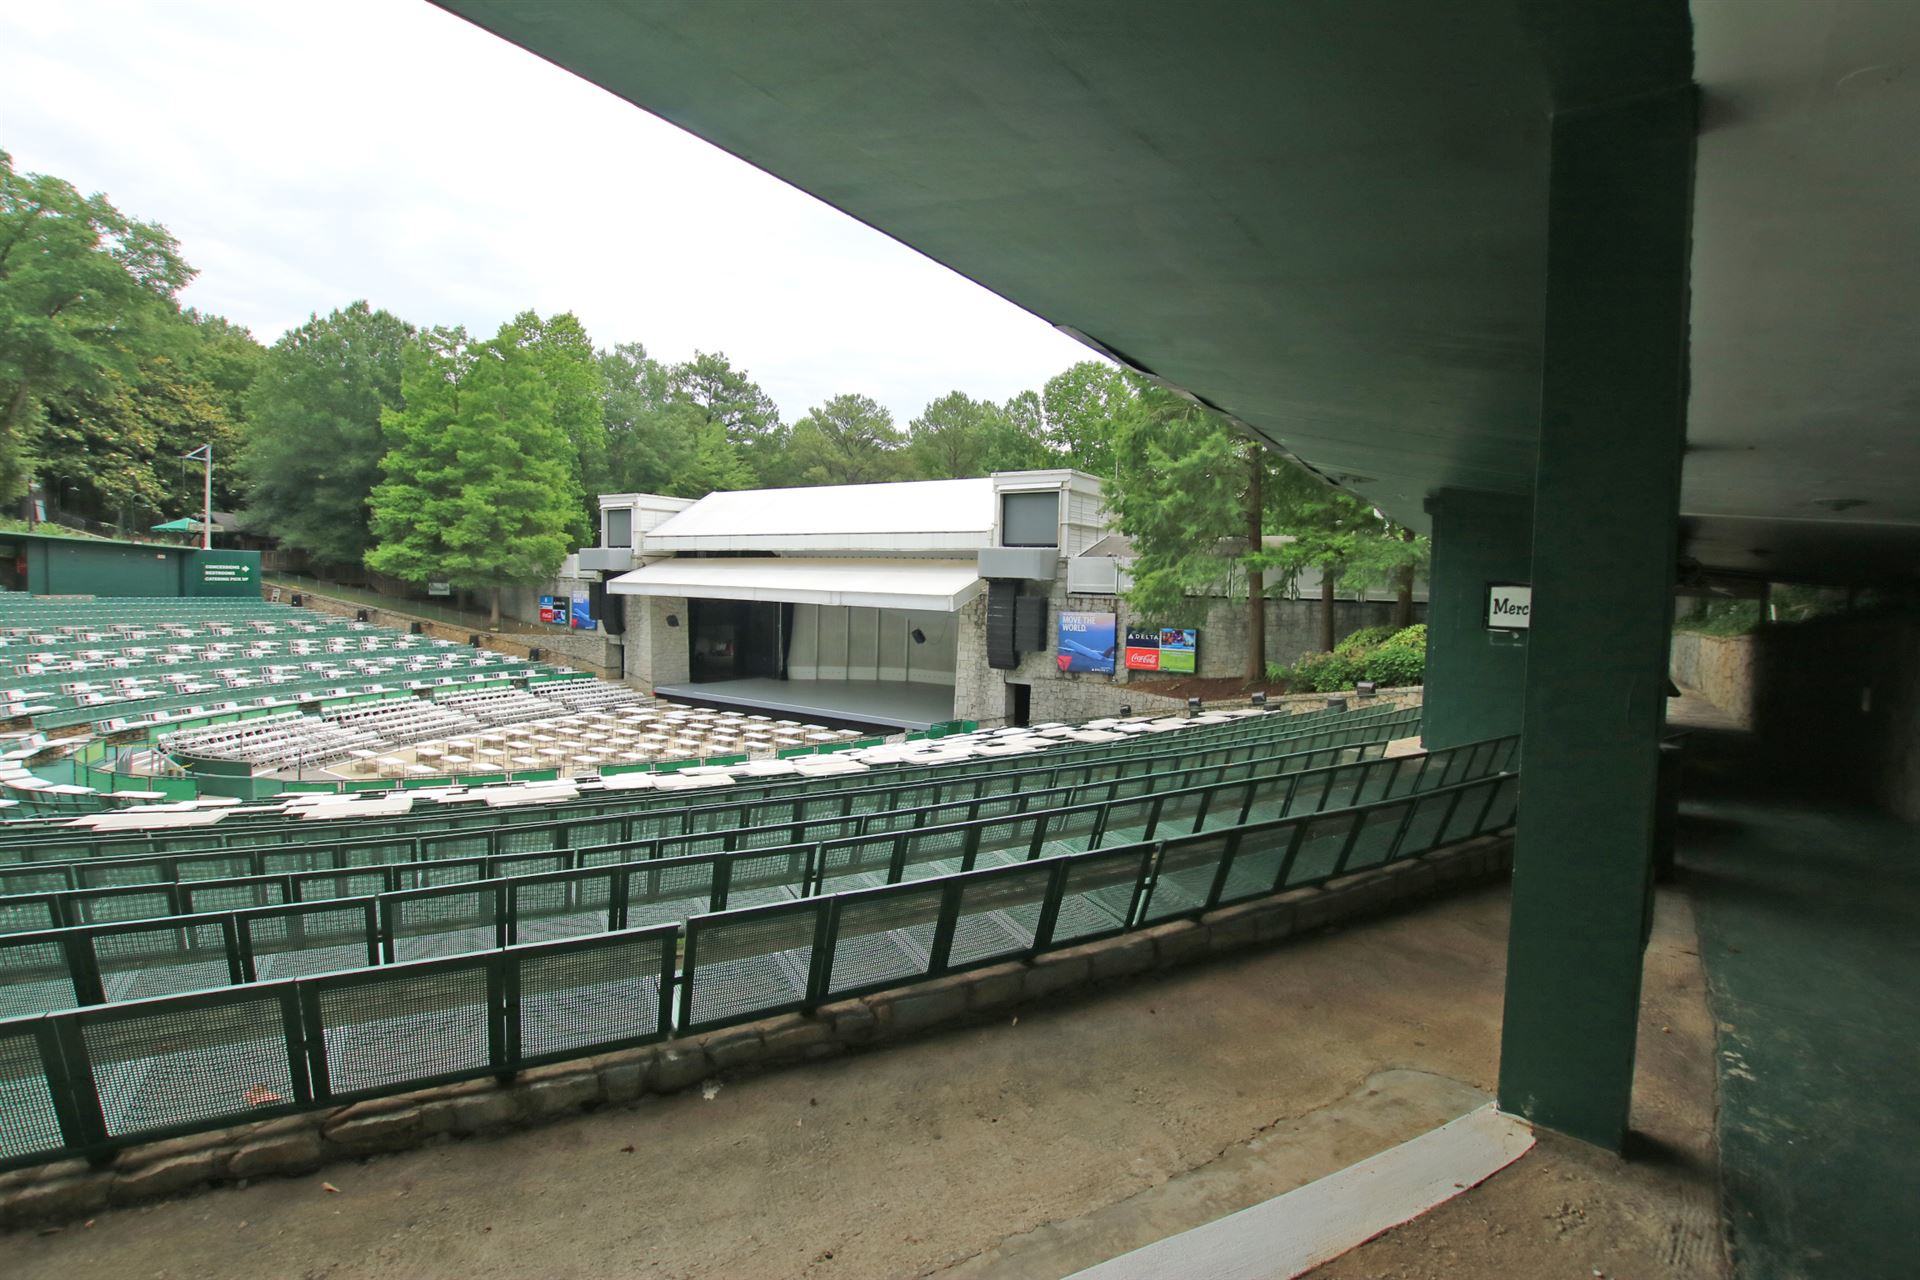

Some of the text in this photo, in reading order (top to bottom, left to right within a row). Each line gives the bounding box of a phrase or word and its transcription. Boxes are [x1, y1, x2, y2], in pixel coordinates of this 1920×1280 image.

[1493, 598, 1529, 616] Merc
[1062, 615, 1096, 625] MOVE THE
[1062, 624, 1088, 632] WORLD.
